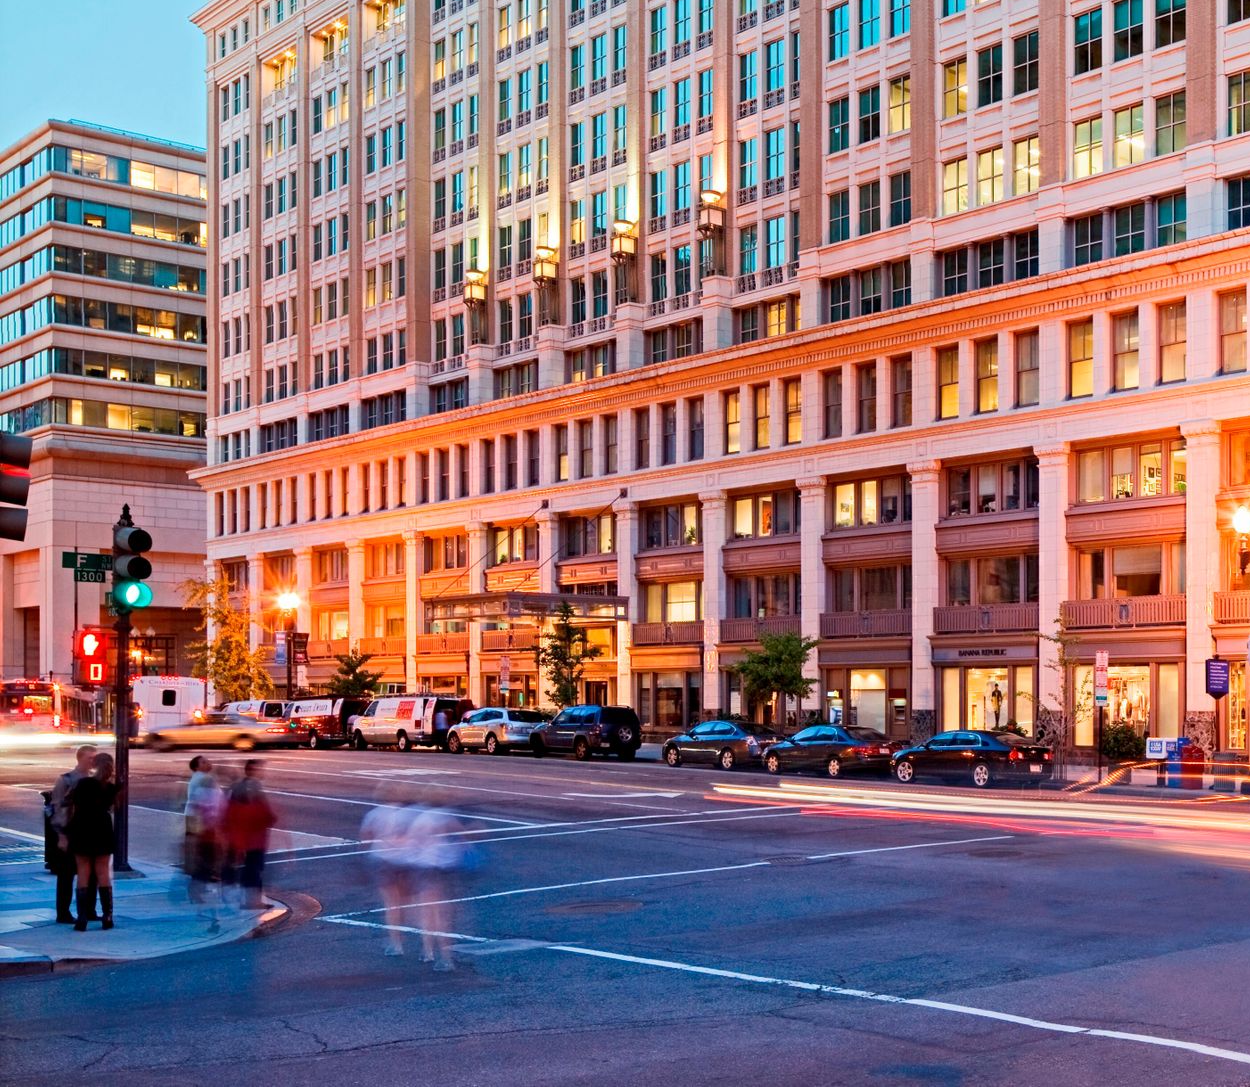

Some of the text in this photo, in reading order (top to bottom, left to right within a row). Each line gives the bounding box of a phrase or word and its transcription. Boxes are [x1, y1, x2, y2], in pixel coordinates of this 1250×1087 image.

[76, 554, 88, 568] F
[77, 571, 103, 582] 1300
[958, 648, 1007, 657] BANANA REPUBLIC
